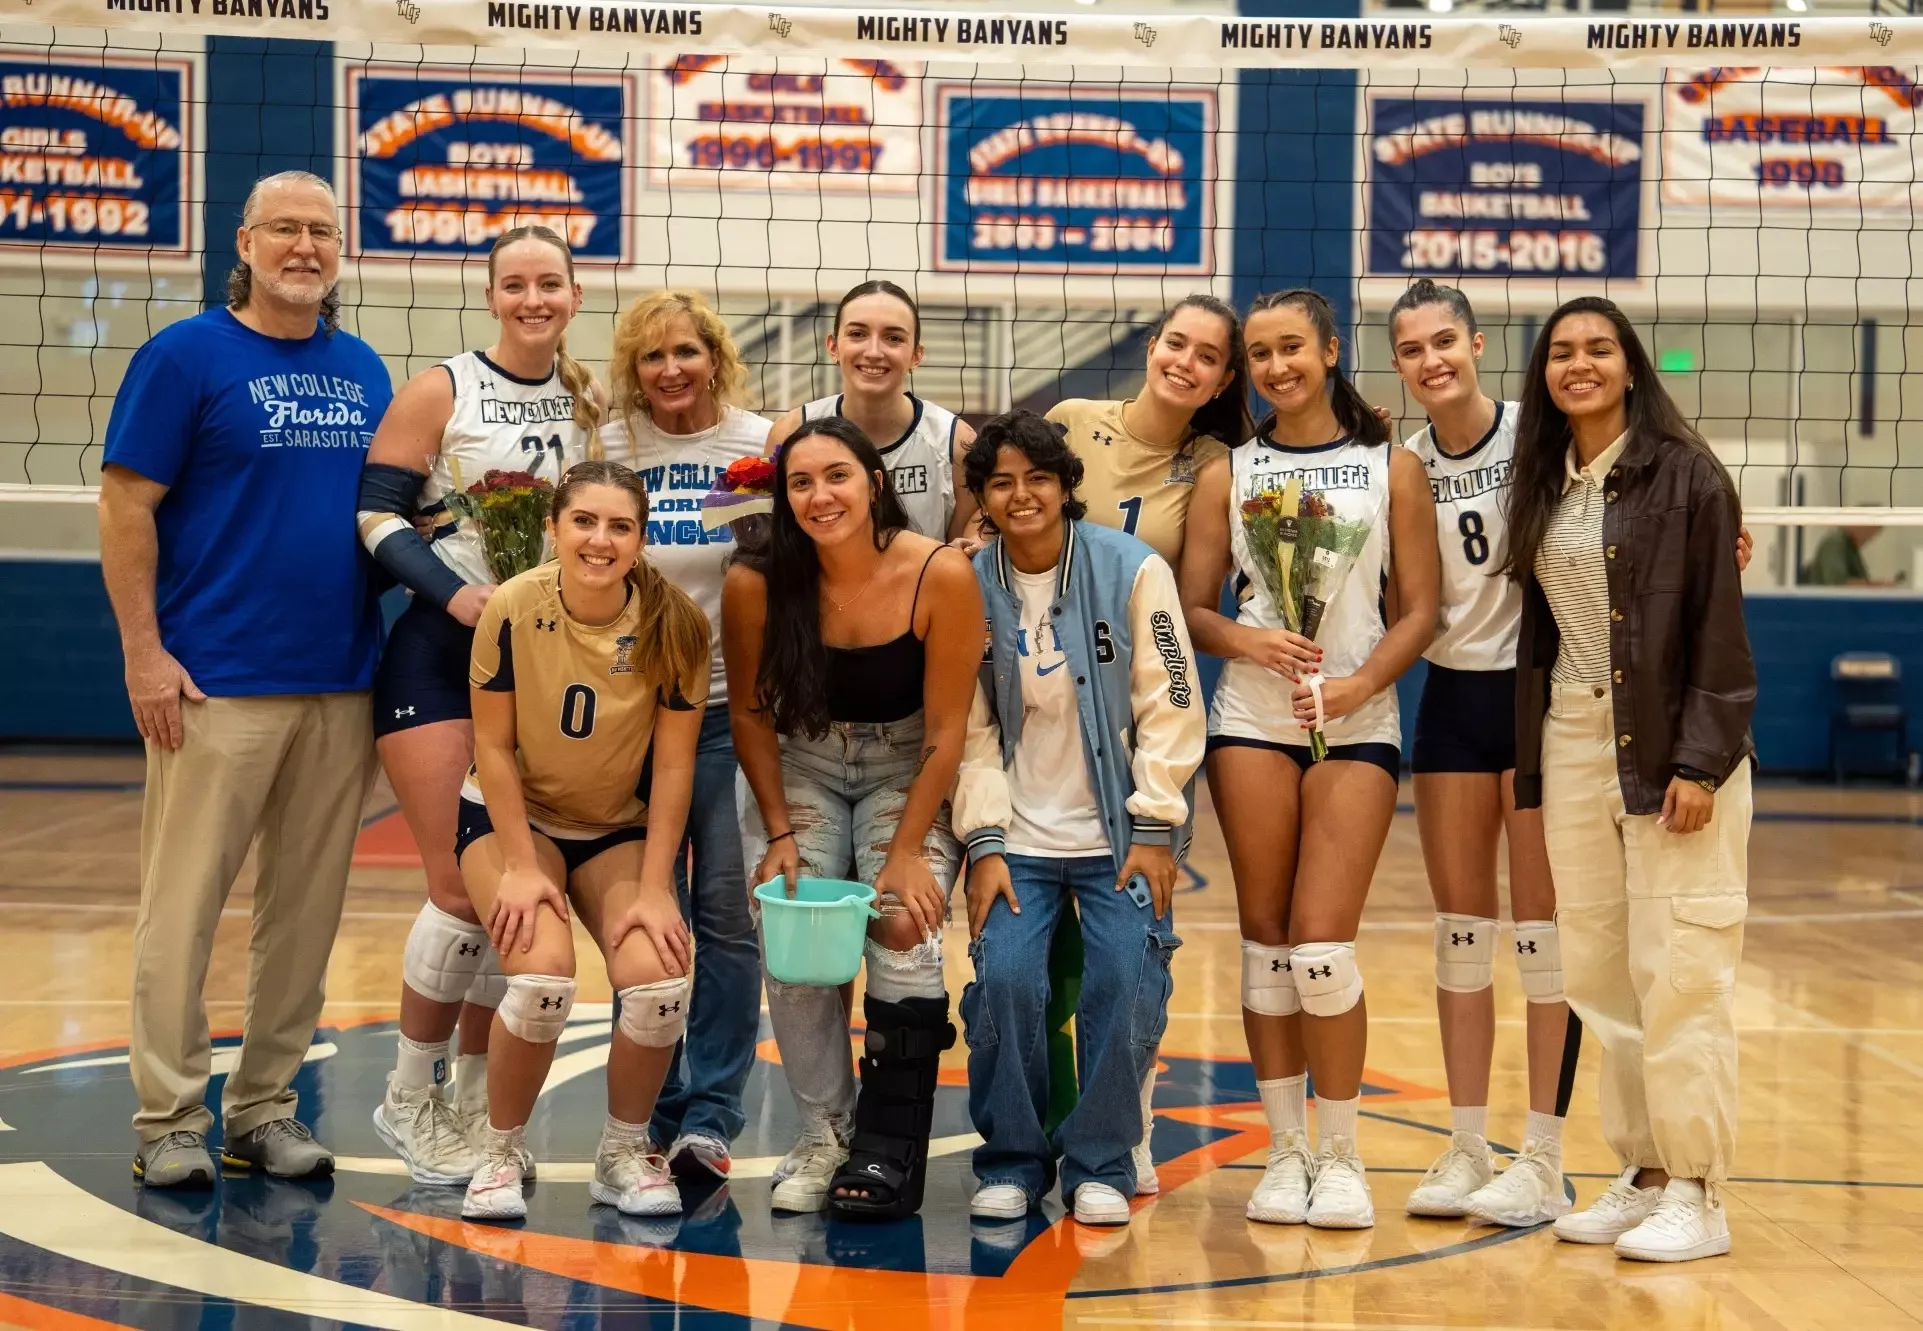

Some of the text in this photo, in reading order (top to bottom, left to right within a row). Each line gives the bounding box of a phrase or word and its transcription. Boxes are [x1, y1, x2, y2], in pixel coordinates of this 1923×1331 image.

[212, 0, 329, 20] BANYANS
[488, 2, 702, 35] MIGHTY BANYANS
[857, 16, 1067, 45] MIGHTY BANYANS
[1221, 23, 1431, 49] MIGHTY BANYANS
[1587, 23, 1801, 49] MIGHTY BANYANS
[1703, 113, 1898, 145] BASEBALL
[0, 190, 149, 236] 1-1992
[248, 373, 369, 408] NEW COLLEGE
[263, 400, 367, 428] Florida
[481, 399, 523, 425] NEW
[263, 433, 282, 443] EST.
[285, 429, 360, 448] SARASOTA
[521, 434, 564, 477] 21
[888, 465, 927, 494] EGE
[1117, 495, 1143, 536] 1
[1458, 511, 1489, 565] 8
[559, 683, 598, 740] 0
